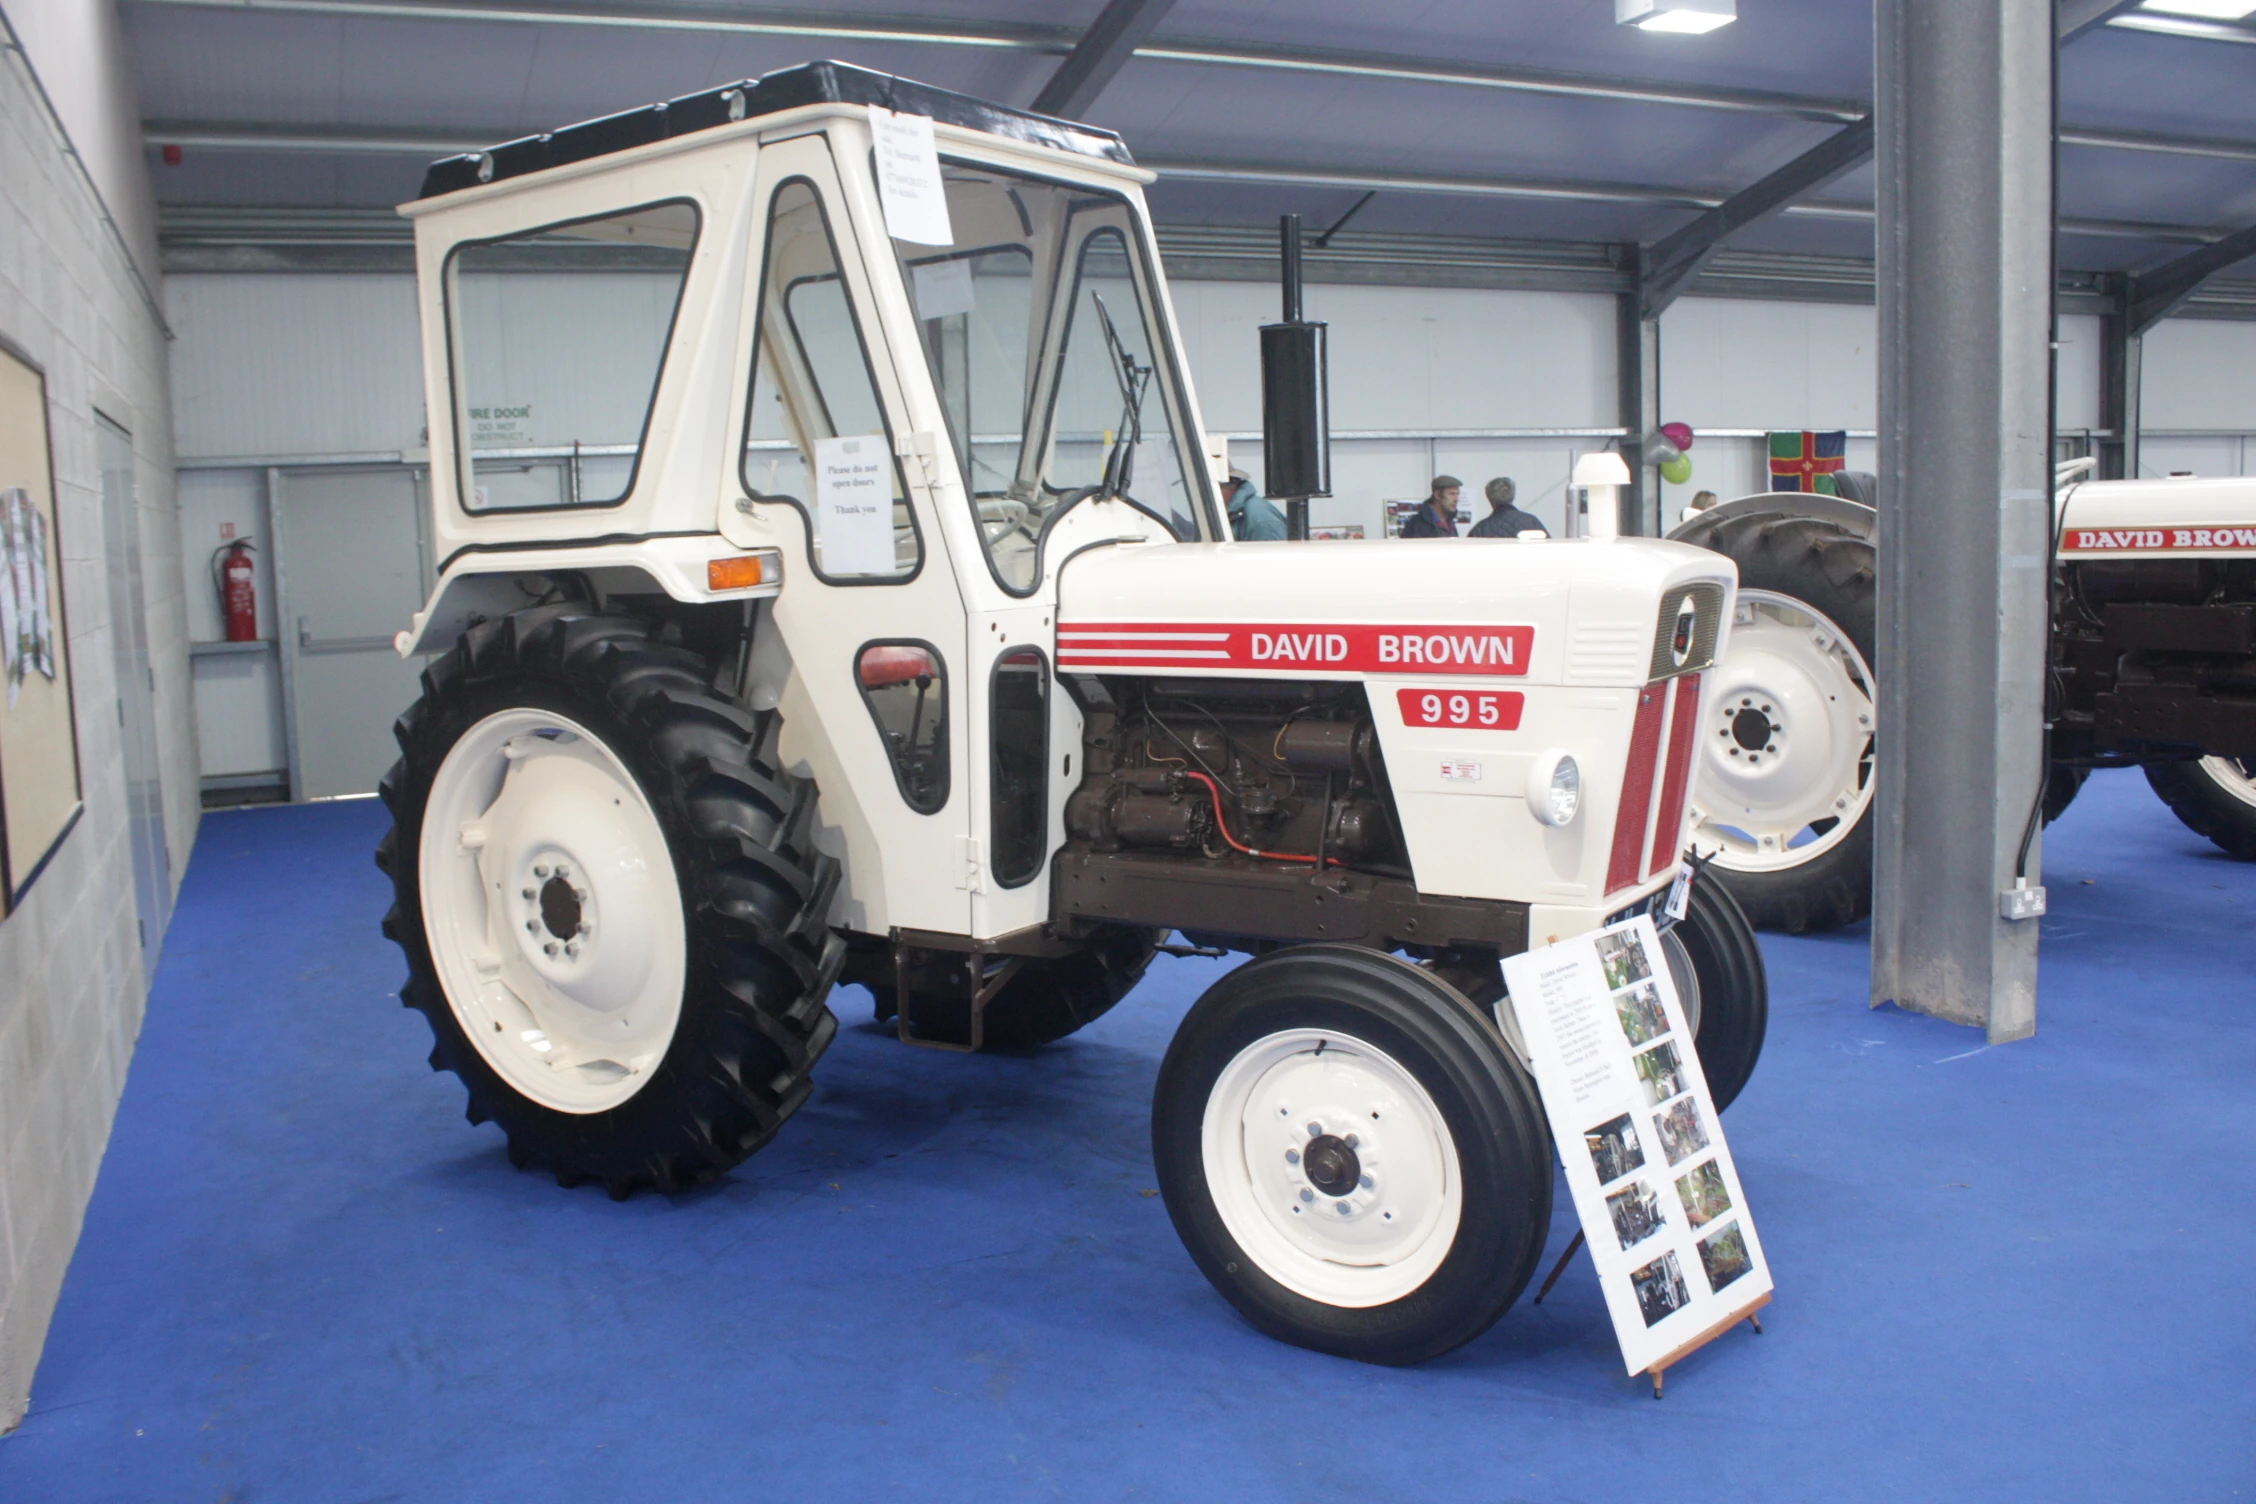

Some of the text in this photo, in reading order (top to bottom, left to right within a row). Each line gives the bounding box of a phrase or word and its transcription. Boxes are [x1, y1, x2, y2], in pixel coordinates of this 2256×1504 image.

[494, 408, 530, 419] DOOR
[477, 422, 516, 431] DO NOT
[471, 432, 524, 441] OBSTRUCT
[827, 464, 878, 475] Please do not
[832, 478, 875, 490] open doors
[835, 505, 876, 516] Thank you
[2078, 531, 2164, 548] DAVID
[1251, 633, 1513, 664] DAVID BROWN
[1421, 694, 1499, 724] 995
